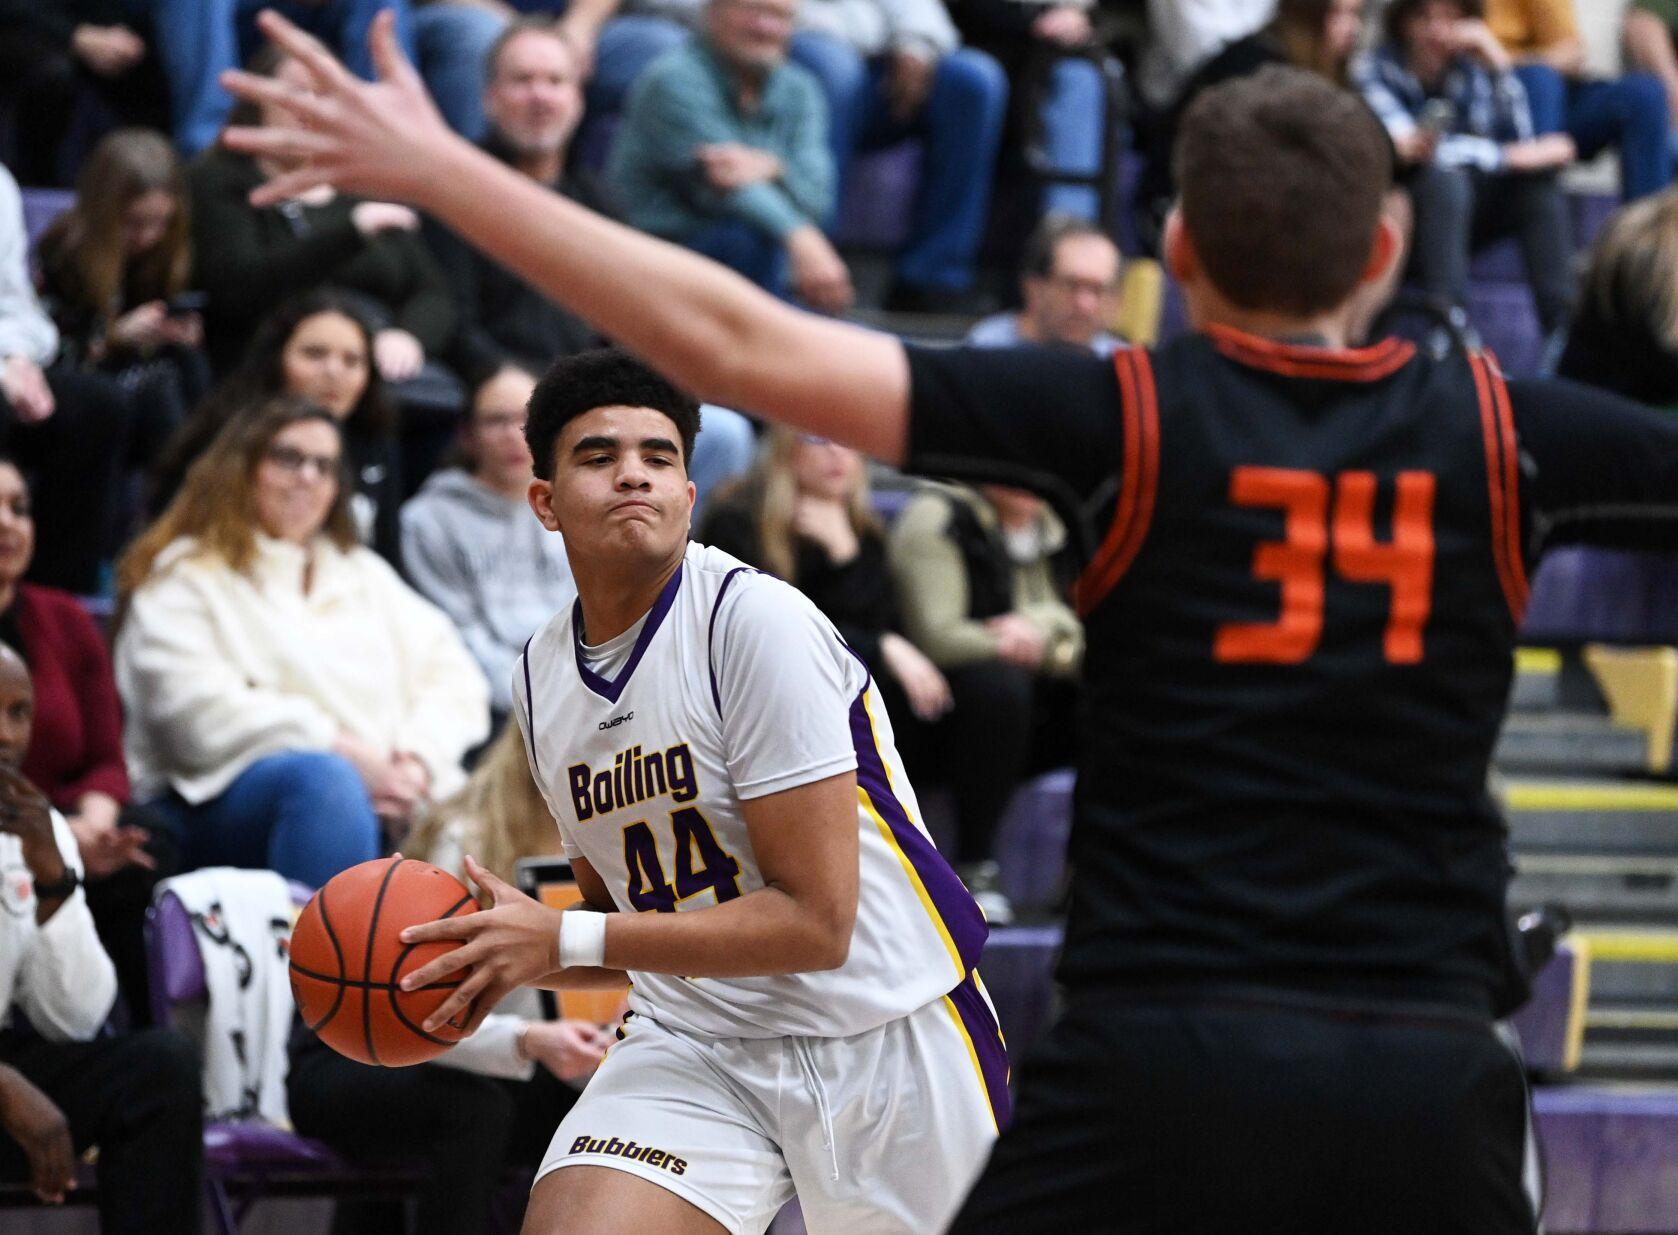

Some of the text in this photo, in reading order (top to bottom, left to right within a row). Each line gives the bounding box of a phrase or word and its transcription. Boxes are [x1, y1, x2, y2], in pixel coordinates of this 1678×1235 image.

[1213, 465, 1436, 664] 34
[567, 742, 699, 823] Boiling
[622, 806, 742, 913] 44
[568, 1135, 688, 1176] Bubblers
